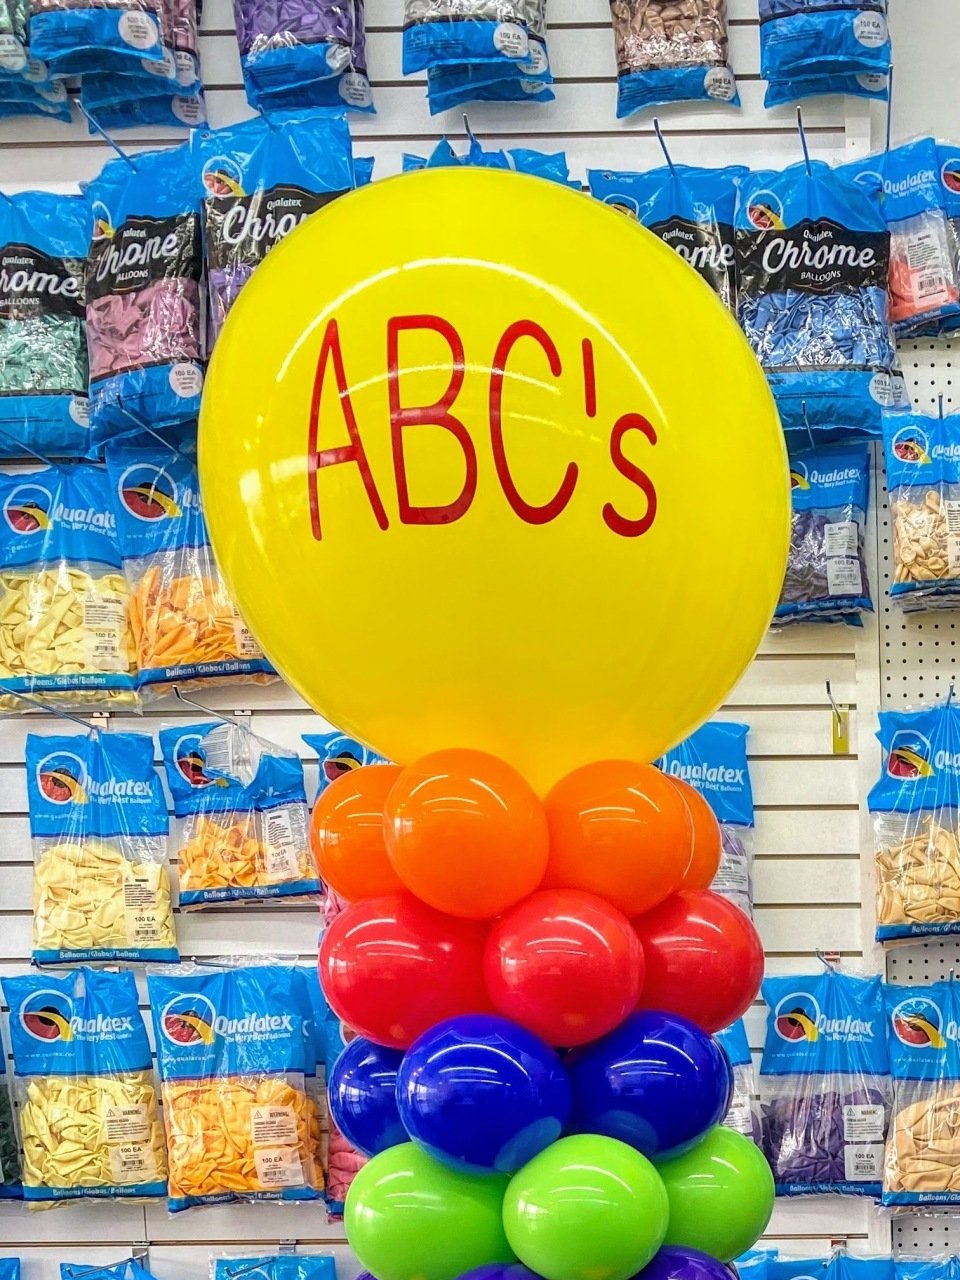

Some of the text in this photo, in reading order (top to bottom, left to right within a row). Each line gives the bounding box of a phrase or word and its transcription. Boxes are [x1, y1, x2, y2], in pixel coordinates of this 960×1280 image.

[884, 170, 936, 194] Qualatex
[267, 198, 302, 210] Qualatex
[662, 229, 694, 241] Qualatex
[803, 230, 833, 243] Qualatex
[762, 237, 876, 274] Chrome
[0, 268, 79, 298] rome
[800, 270, 841, 282] BALLOONS
[308, 314, 657, 541] ABC's
[810, 468, 860, 484] Qualatex
[166, 663, 250, 678] Balloons/Globos/Ballons
[670, 760, 744, 785] Qualatex
[705, 781, 719, 791] Best
[60, 951, 140, 959] Balloons/Globos/Ballons
[214, 1014, 293, 1034] Qualatex
[235, 1033, 252, 1043] Very
[253, 1033, 269, 1041] Best
[52, 1187, 136, 1196] Balloons/Globos/Ballons
